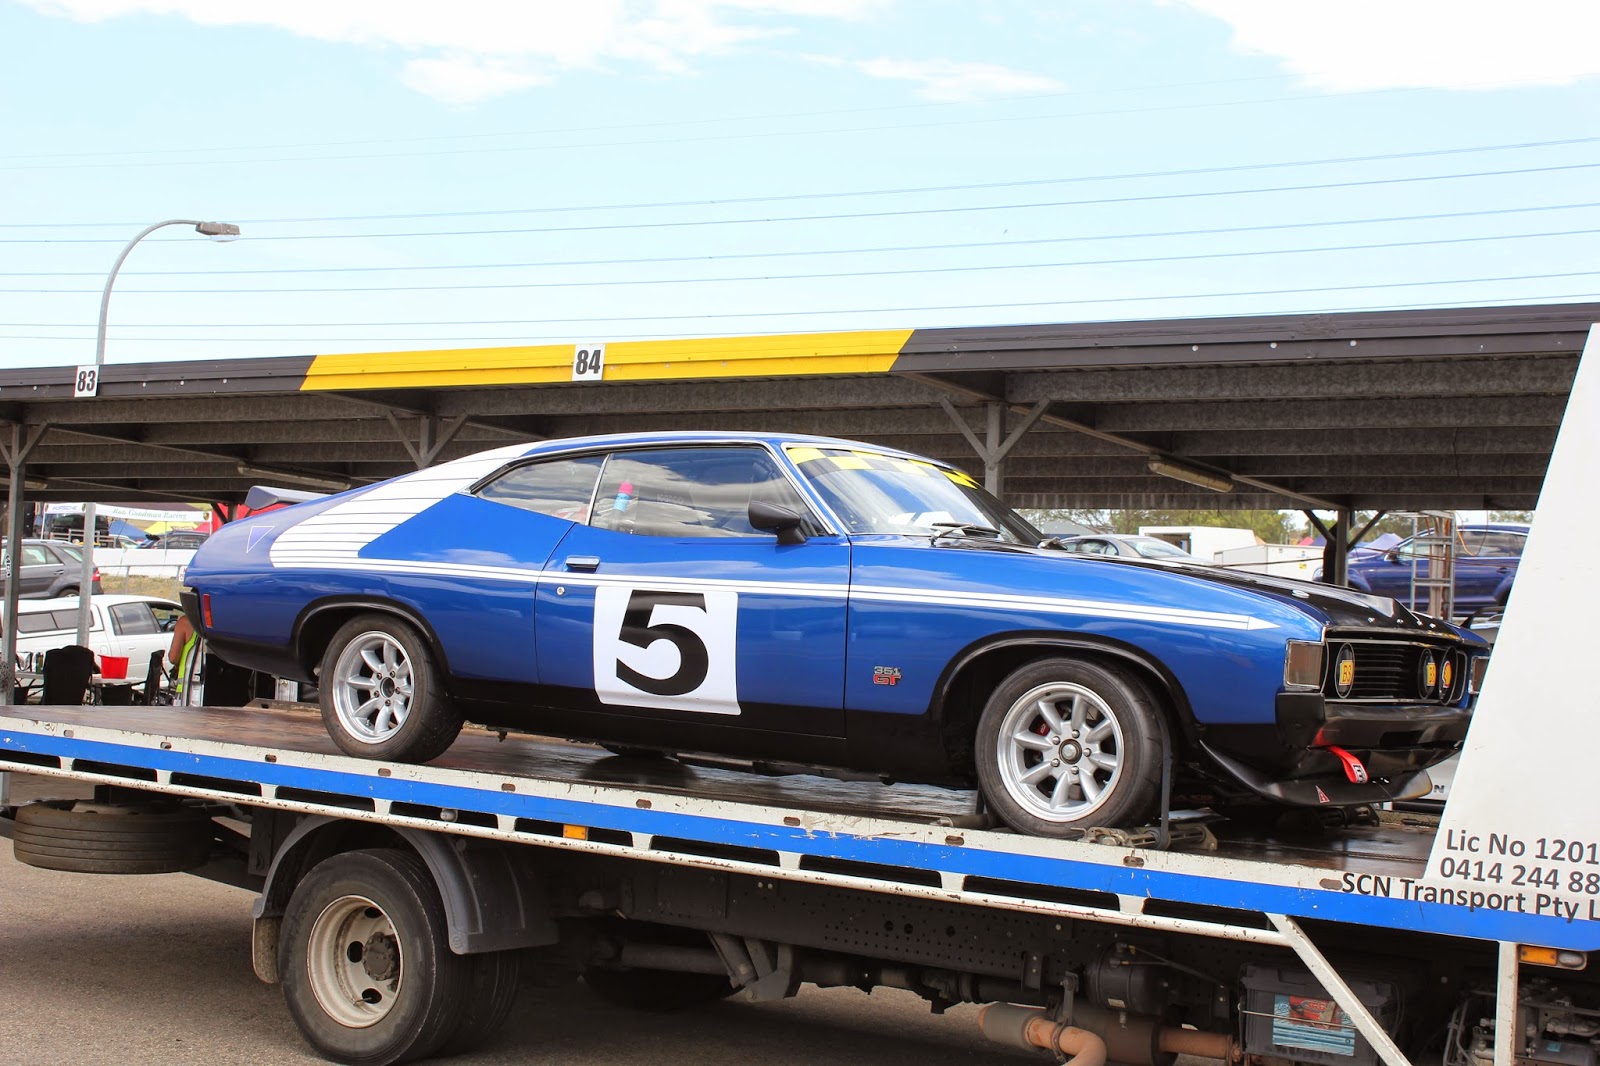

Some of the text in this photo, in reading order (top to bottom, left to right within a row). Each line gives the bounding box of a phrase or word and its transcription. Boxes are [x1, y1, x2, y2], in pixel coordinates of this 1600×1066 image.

[575, 349, 602, 375] 84
[77, 370, 97, 392] 83
[128, 508, 162, 518] Goodman
[163, 511, 187, 520] Racing
[616, 589, 709, 696] 5
[873, 665, 901, 675] 351
[873, 673, 902, 686] GT
[1446, 829, 1600, 865] Lic No 1201
[1440, 857, 1600, 895] 0414 244 88
[1342, 872, 1391, 897] SCN
[1399, 878, 1526, 913] Transport
[1535, 893, 1580, 923] Pty
